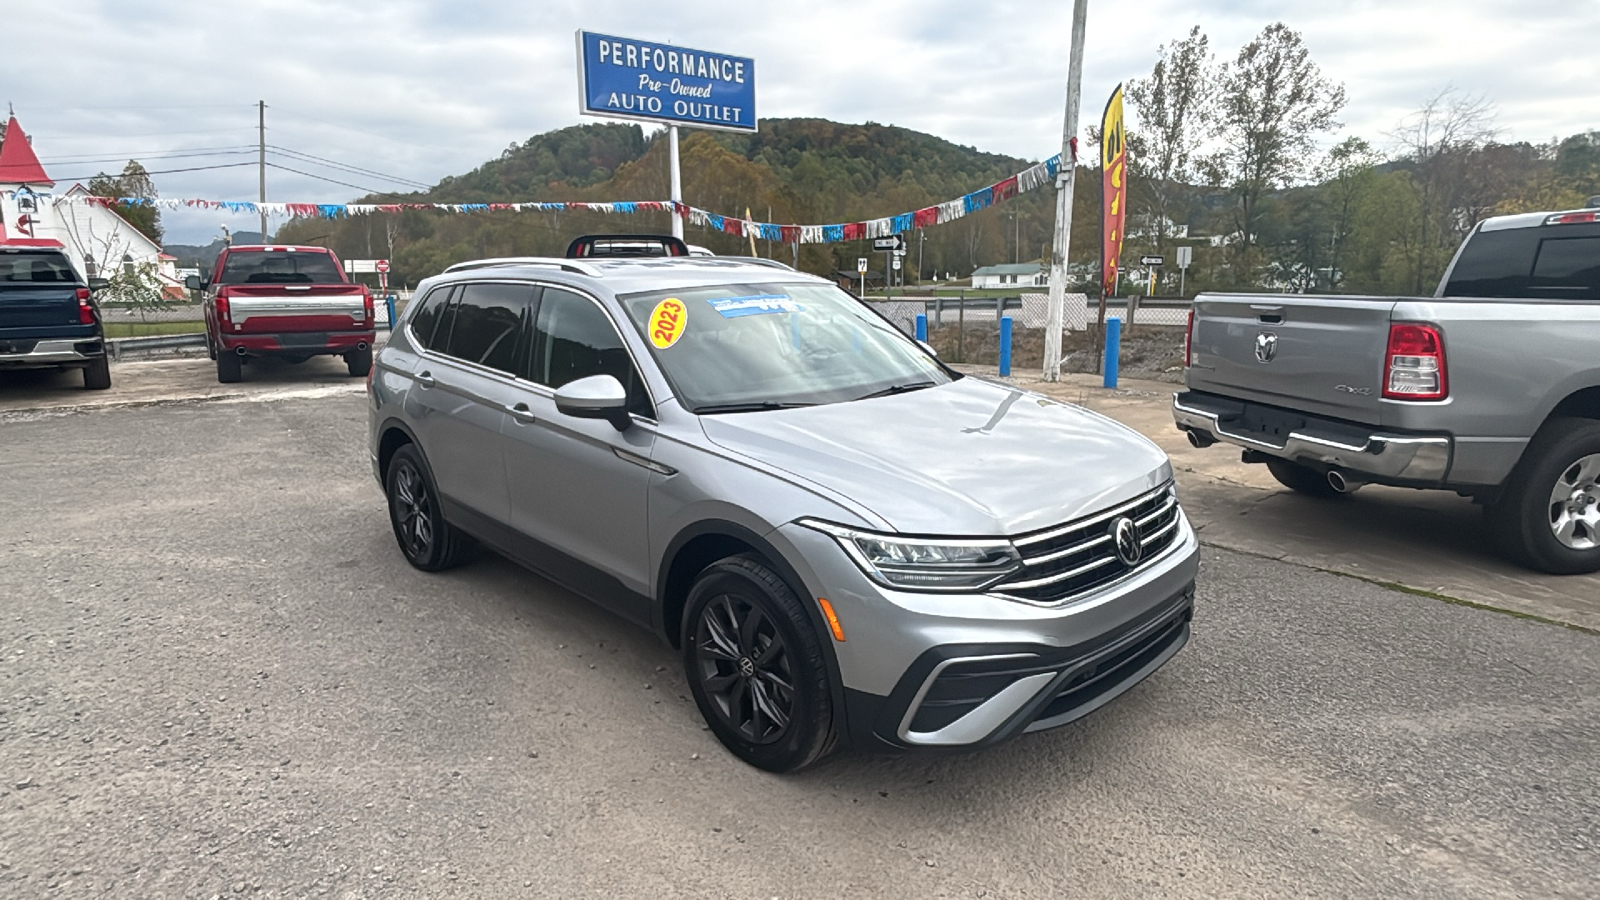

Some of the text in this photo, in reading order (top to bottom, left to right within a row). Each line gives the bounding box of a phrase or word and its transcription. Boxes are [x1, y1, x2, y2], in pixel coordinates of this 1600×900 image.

[599, 39, 745, 84] PERFORMANCE
[638, 74, 713, 98] Pre-Owned
[607, 92, 742, 123] AUTO OUTLET
[654, 301, 682, 343] 2023
